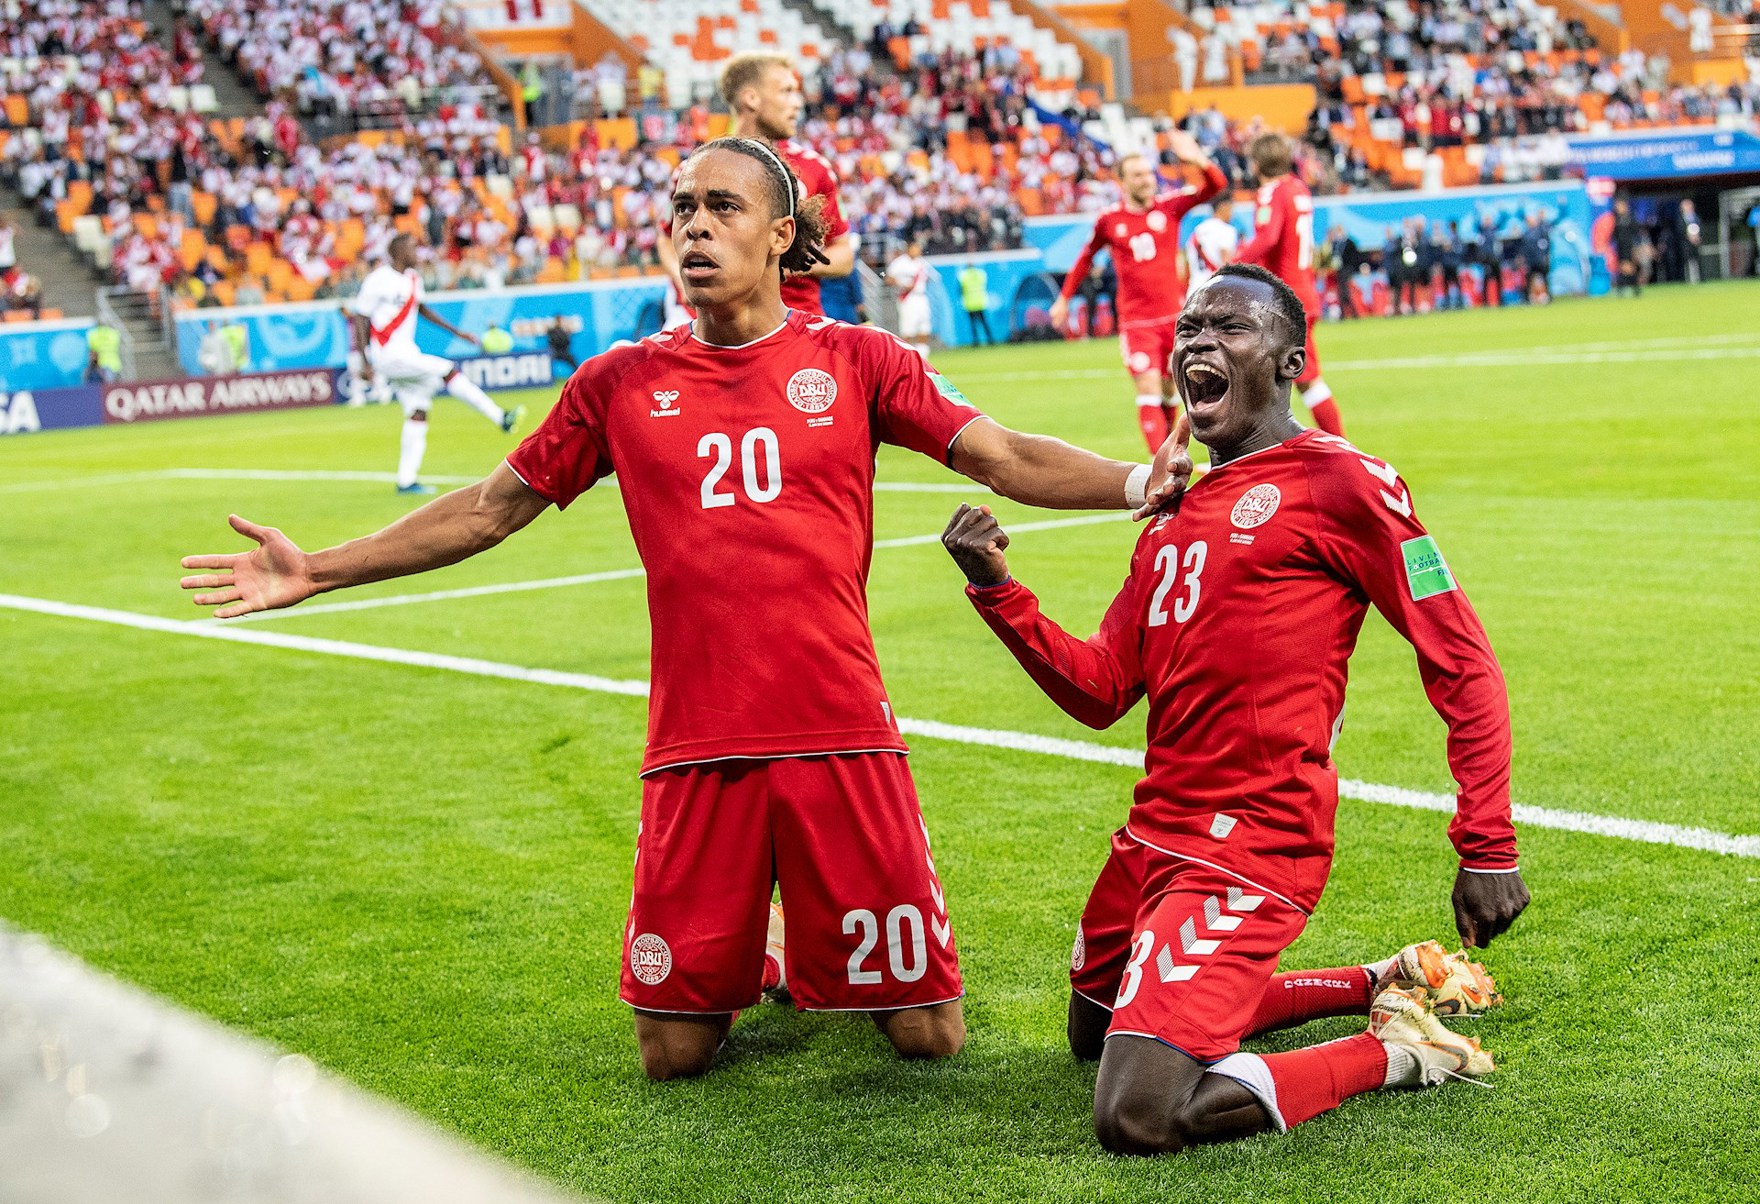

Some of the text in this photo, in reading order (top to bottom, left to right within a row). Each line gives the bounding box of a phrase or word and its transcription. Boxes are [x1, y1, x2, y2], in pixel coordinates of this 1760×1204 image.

[105, 372, 332, 422] QATAR AIRWAYS
[799, 383, 827, 397] DBU
[650, 407, 680, 418] hummel
[697, 427, 783, 509] 20
[1242, 497, 1271, 512] DBU
[1408, 558, 1440, 571] FOOTBA
[1148, 540, 1208, 627] 23
[842, 904, 928, 984] 20
[640, 951, 663, 966] DBU
[1284, 978, 1351, 989] DANMARK
